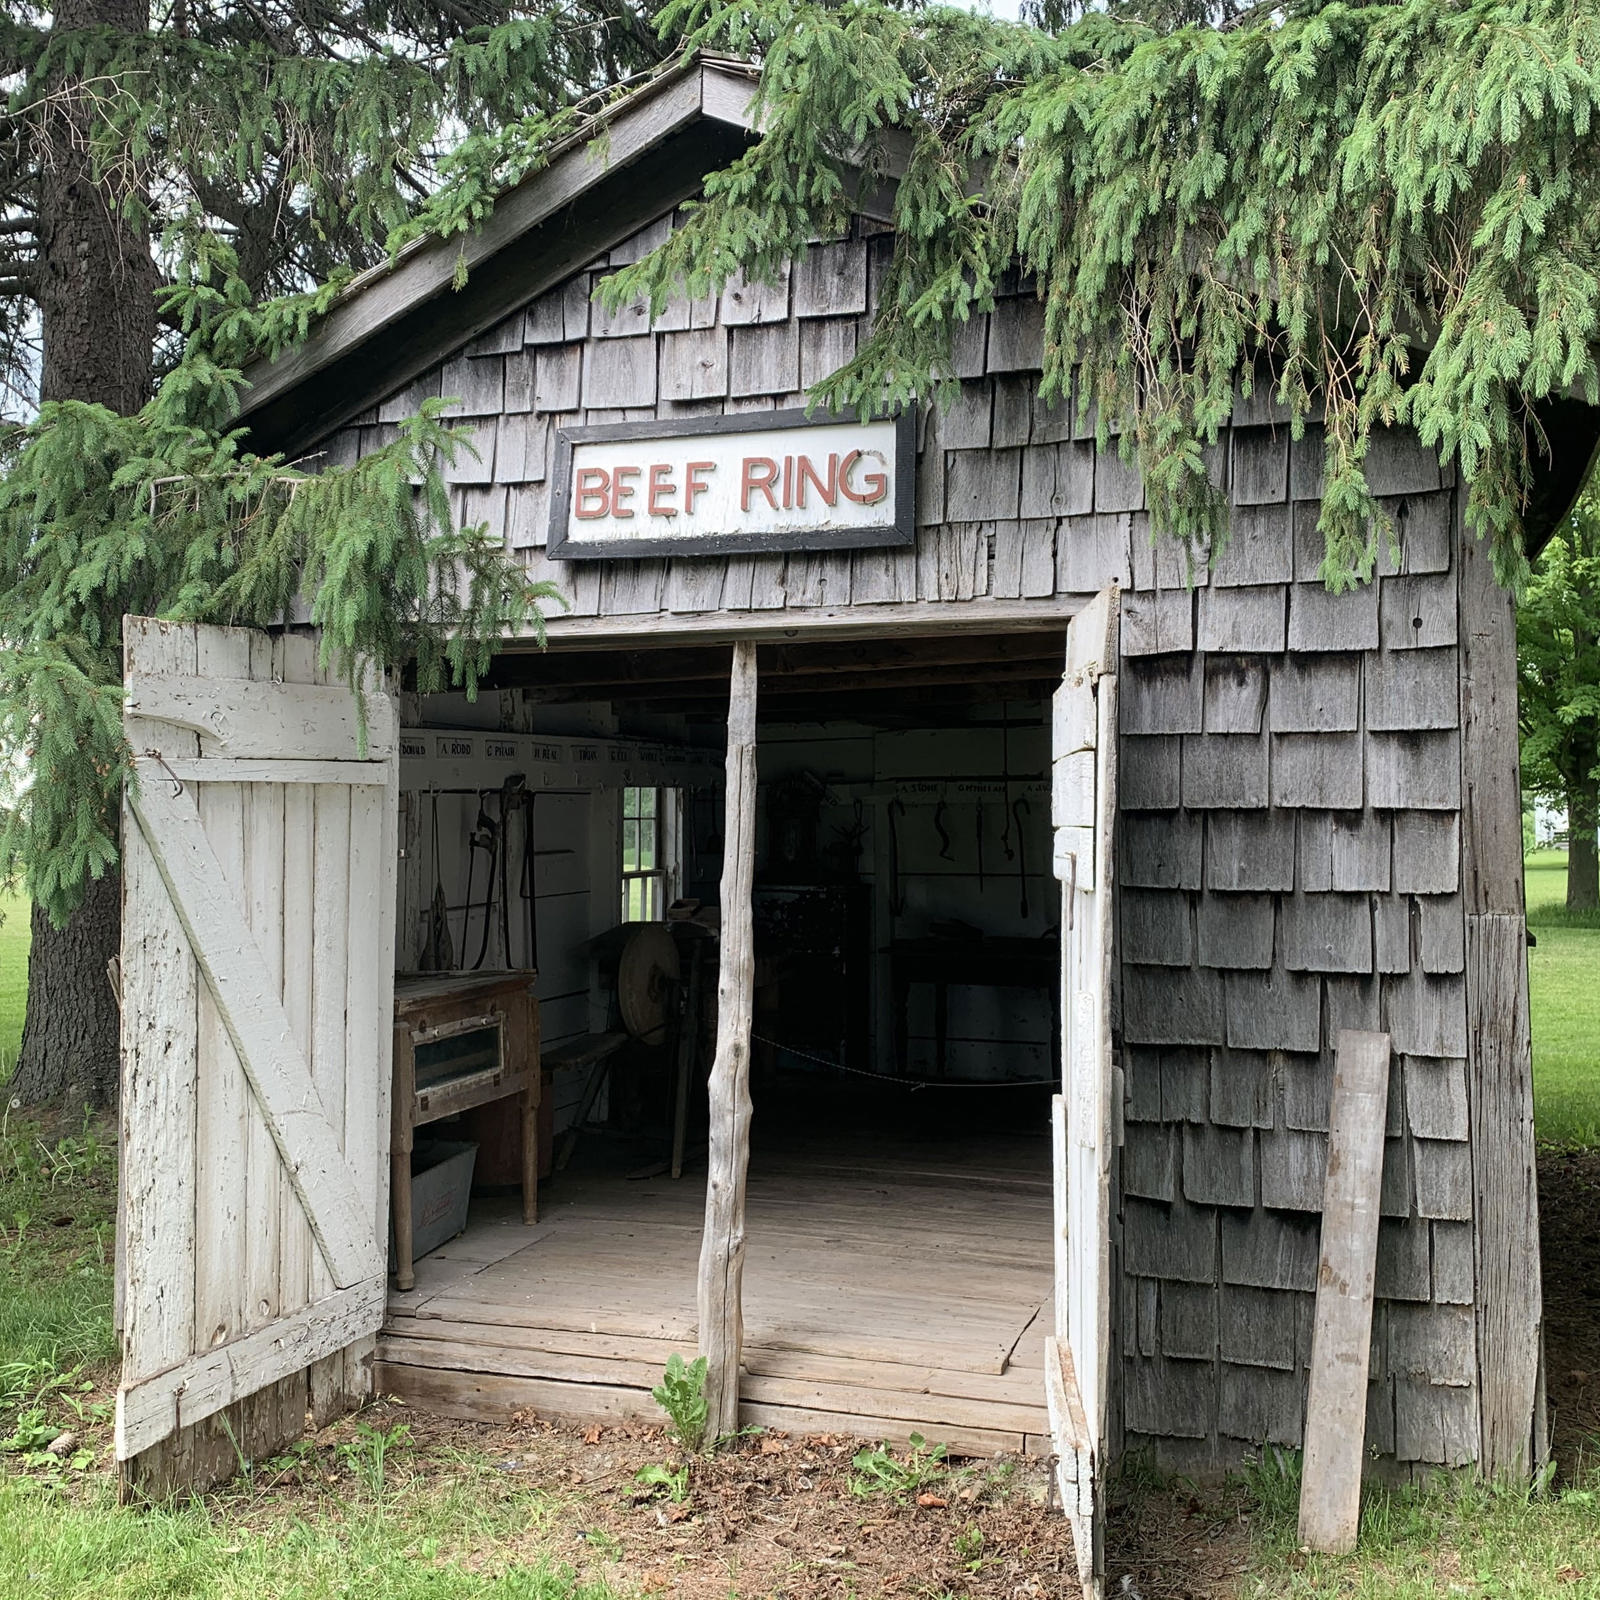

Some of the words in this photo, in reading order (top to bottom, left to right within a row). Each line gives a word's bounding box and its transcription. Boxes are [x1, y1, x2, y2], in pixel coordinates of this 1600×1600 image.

[575, 462, 717, 519] BEEF
[740, 449, 888, 512] RING
[451, 743, 472, 755] RODD
